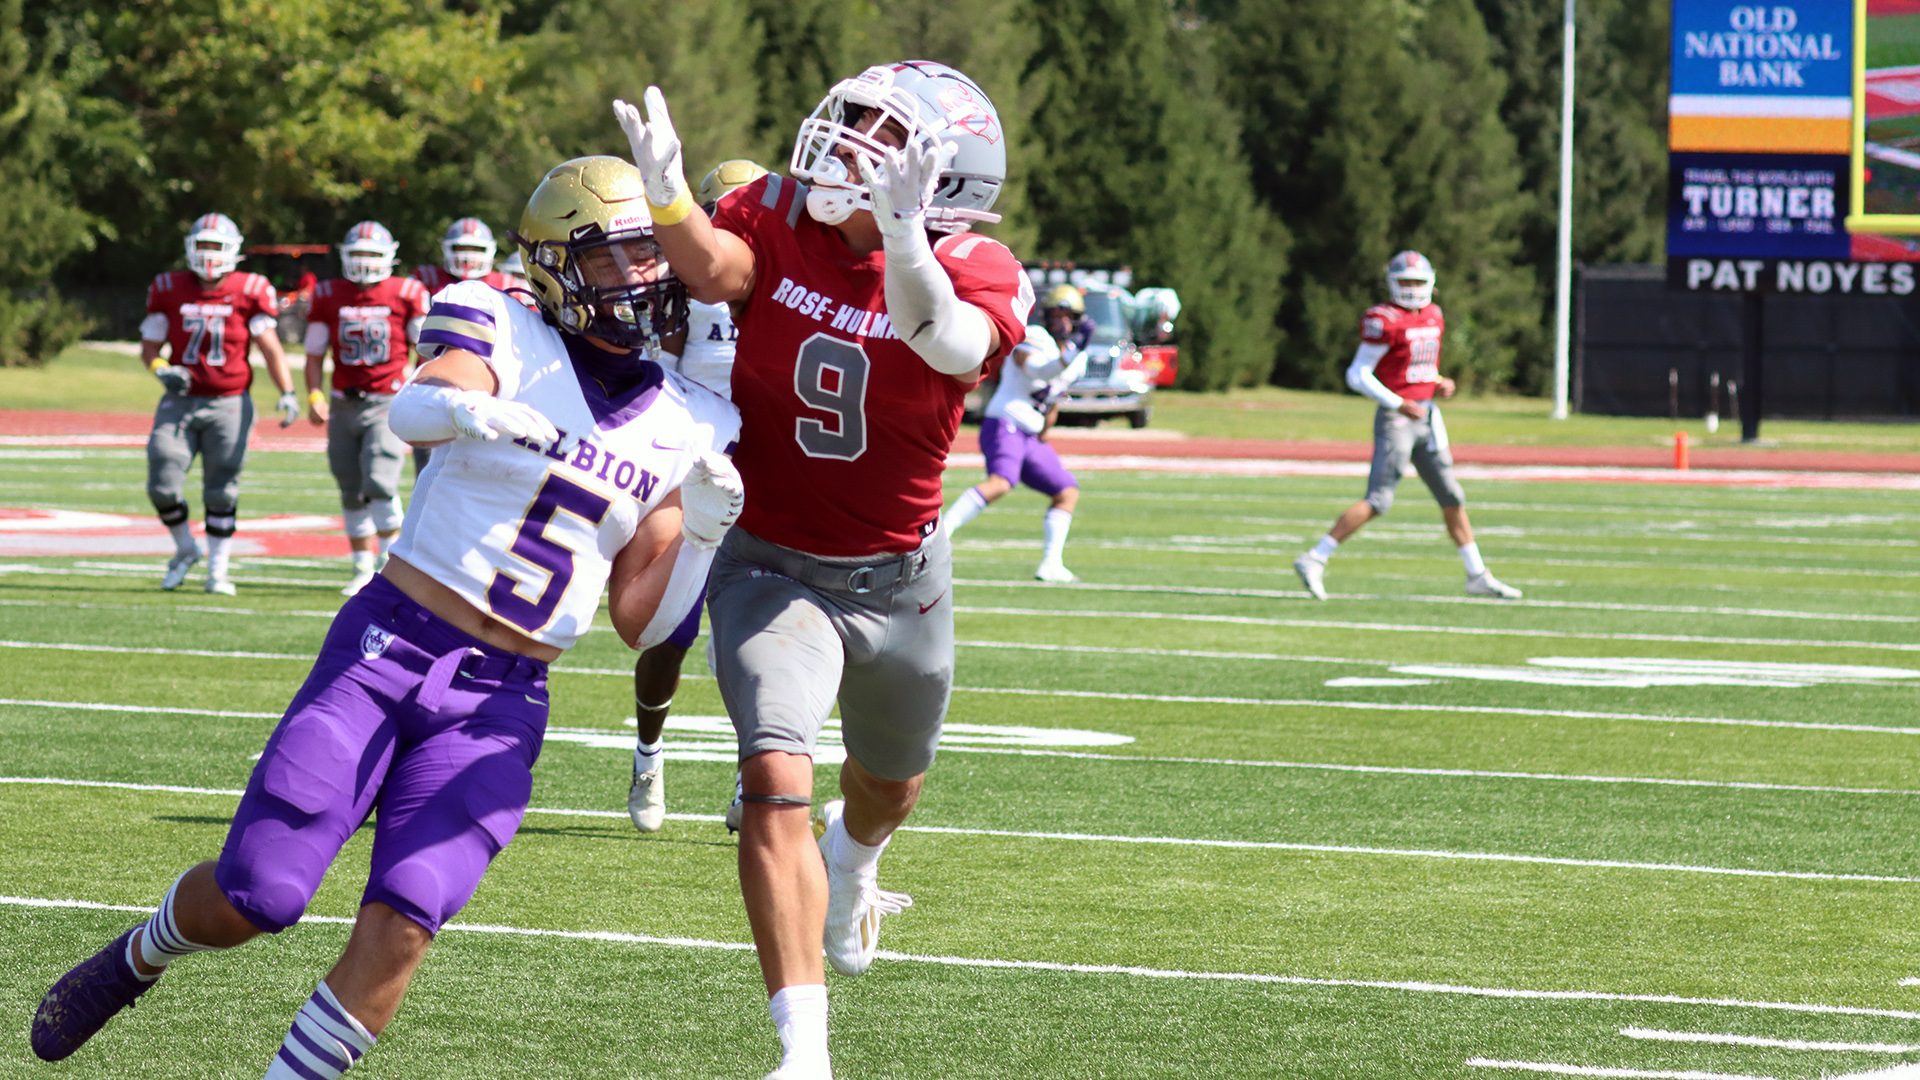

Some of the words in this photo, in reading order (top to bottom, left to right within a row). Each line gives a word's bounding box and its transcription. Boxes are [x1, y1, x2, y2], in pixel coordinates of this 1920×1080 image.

[1729, 6, 1798, 32] OLD
[1685, 32, 1841, 59] NATIONAL
[1719, 60, 1804, 87] BANK
[1683, 184, 1836, 219] TURNER
[1687, 259, 1764, 290] PAT
[1776, 261, 1916, 294] NOYES
[771, 277, 900, 339] ROSE-HULMA
[182, 316, 226, 366] 71
[339, 317, 391, 366] 58
[794, 331, 871, 462] 9
[484, 468, 616, 637] 5
